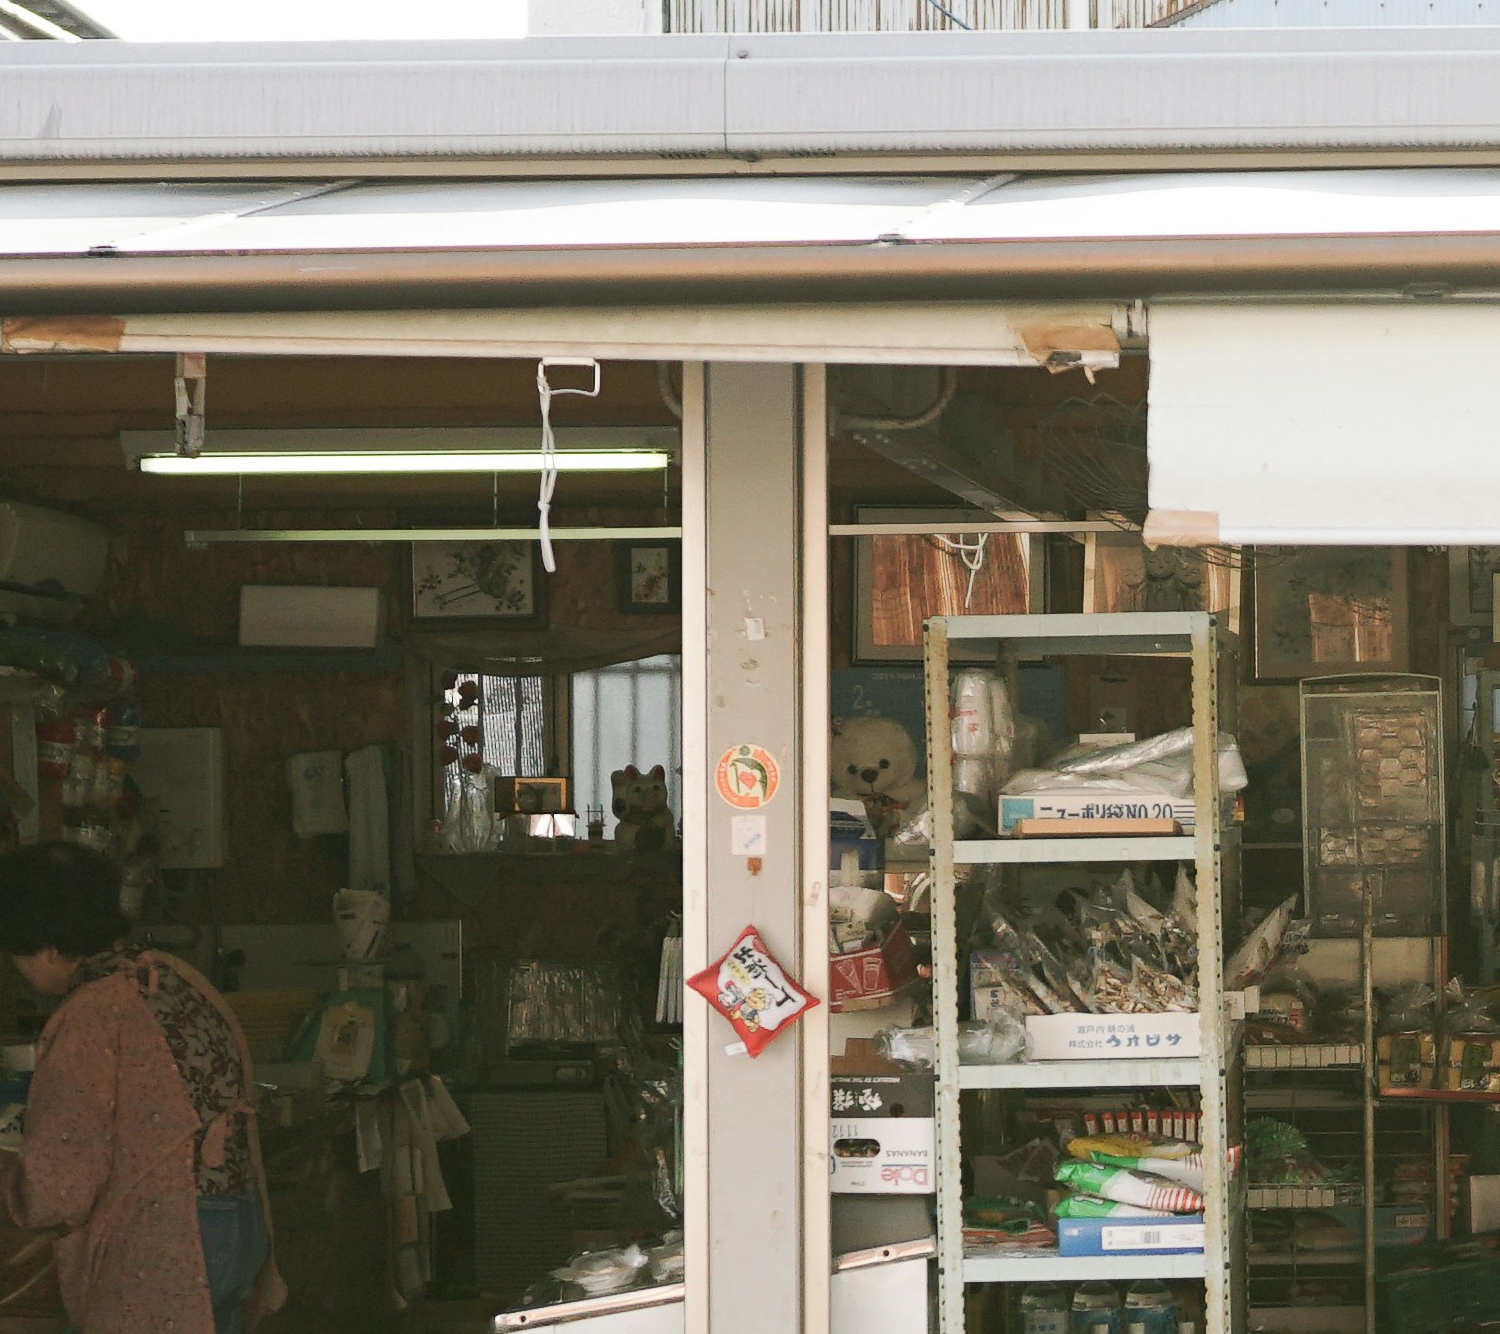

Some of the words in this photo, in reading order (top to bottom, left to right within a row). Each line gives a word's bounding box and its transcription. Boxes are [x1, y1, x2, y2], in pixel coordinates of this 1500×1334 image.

[733, 945, 797, 1008] 出前一丁
[881, 1167, 929, 1186] Dole
